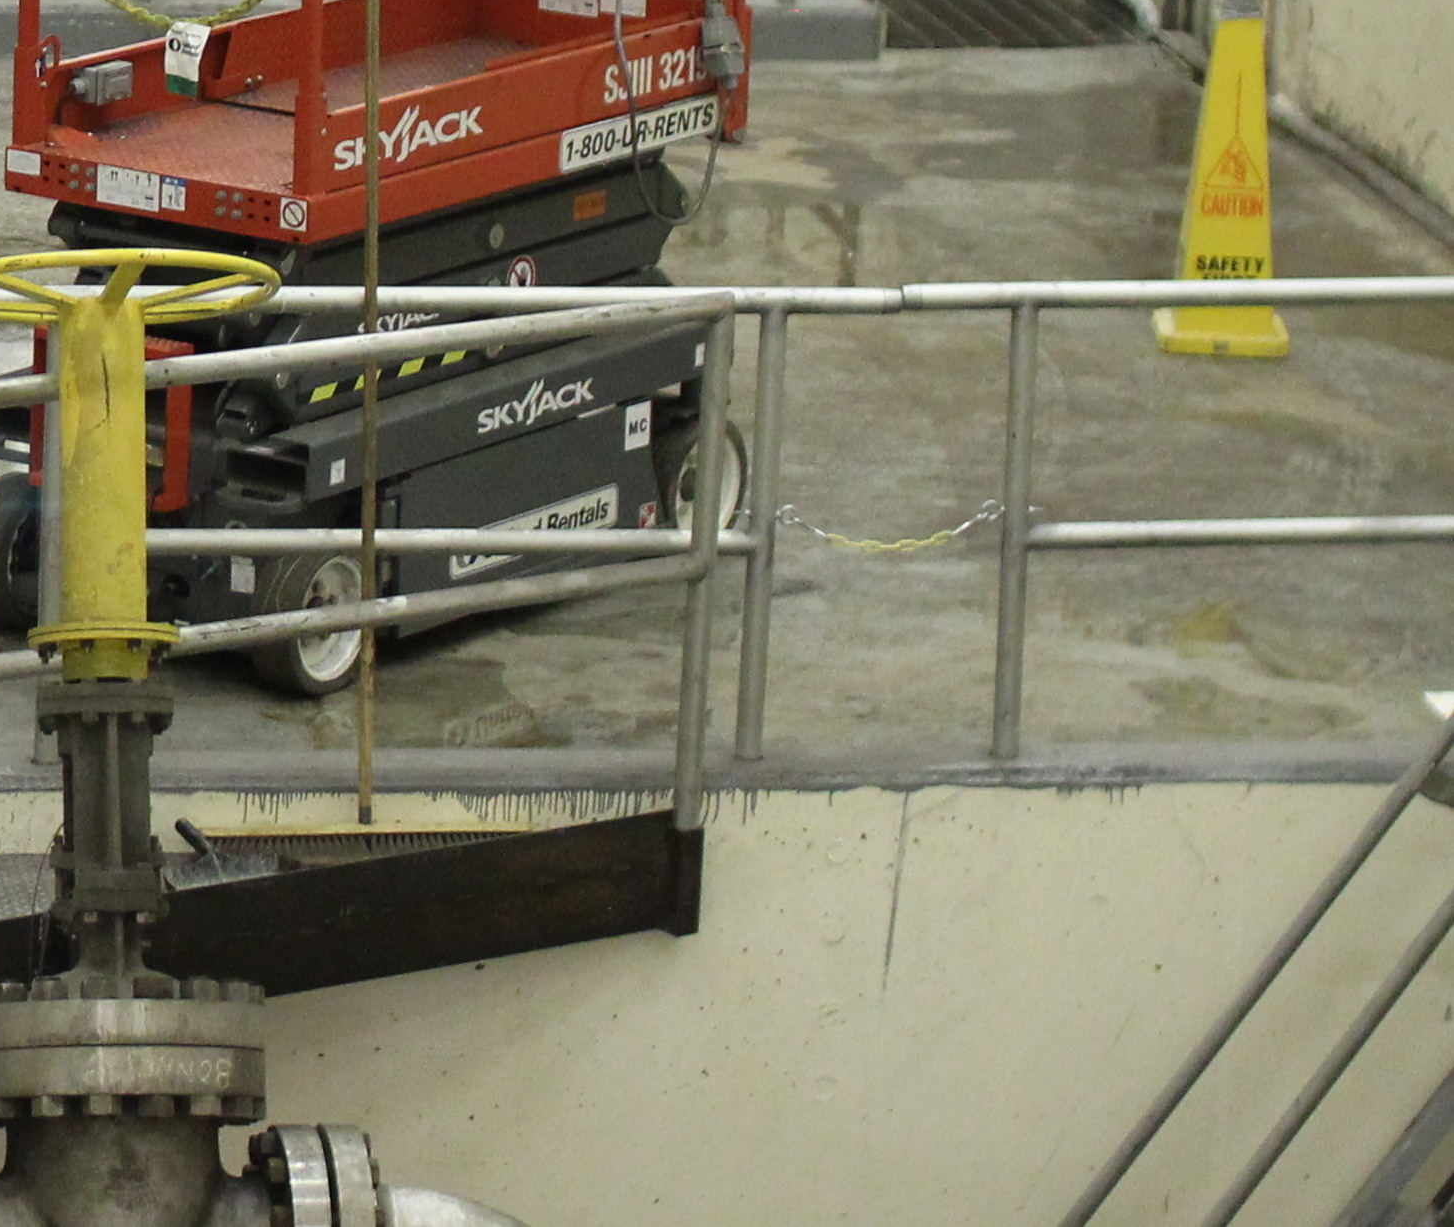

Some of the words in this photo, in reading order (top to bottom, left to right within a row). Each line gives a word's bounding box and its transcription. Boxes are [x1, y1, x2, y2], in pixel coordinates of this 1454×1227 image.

[565, 102, 714, 163] 1-800-UR-RENTS
[1200, 193, 1264, 217] CAUTION
[1196, 255, 1265, 273] SAFETY
[477, 378, 595, 435] SKYJACK
[628, 415, 649, 436] MC
[546, 497, 611, 530] Rentals
